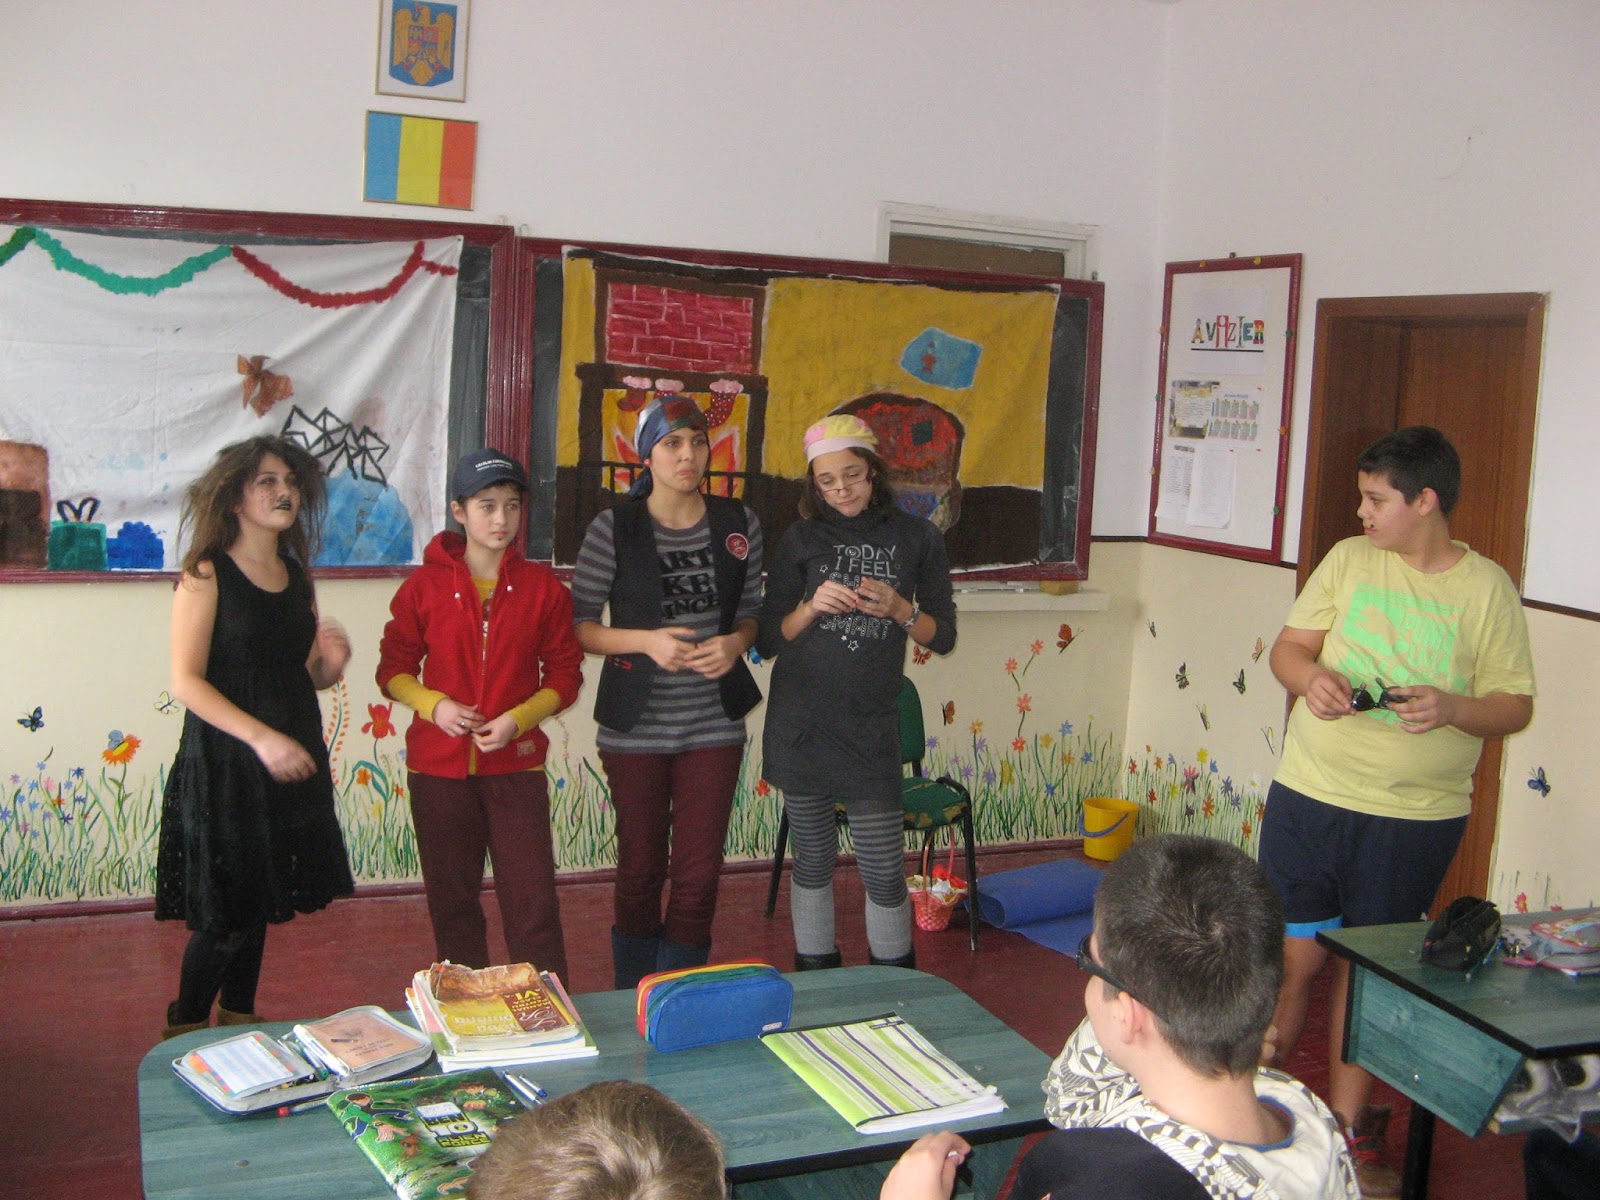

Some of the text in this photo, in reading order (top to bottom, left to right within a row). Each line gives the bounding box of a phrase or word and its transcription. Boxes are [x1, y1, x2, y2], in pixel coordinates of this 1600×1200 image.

[1191, 315, 1265, 348] AVIZIER
[832, 544, 896, 561] TODAY
[835, 556, 897, 578] I FEEL
[820, 613, 893, 640] SMART
[429, 1120, 478, 1137] 10
